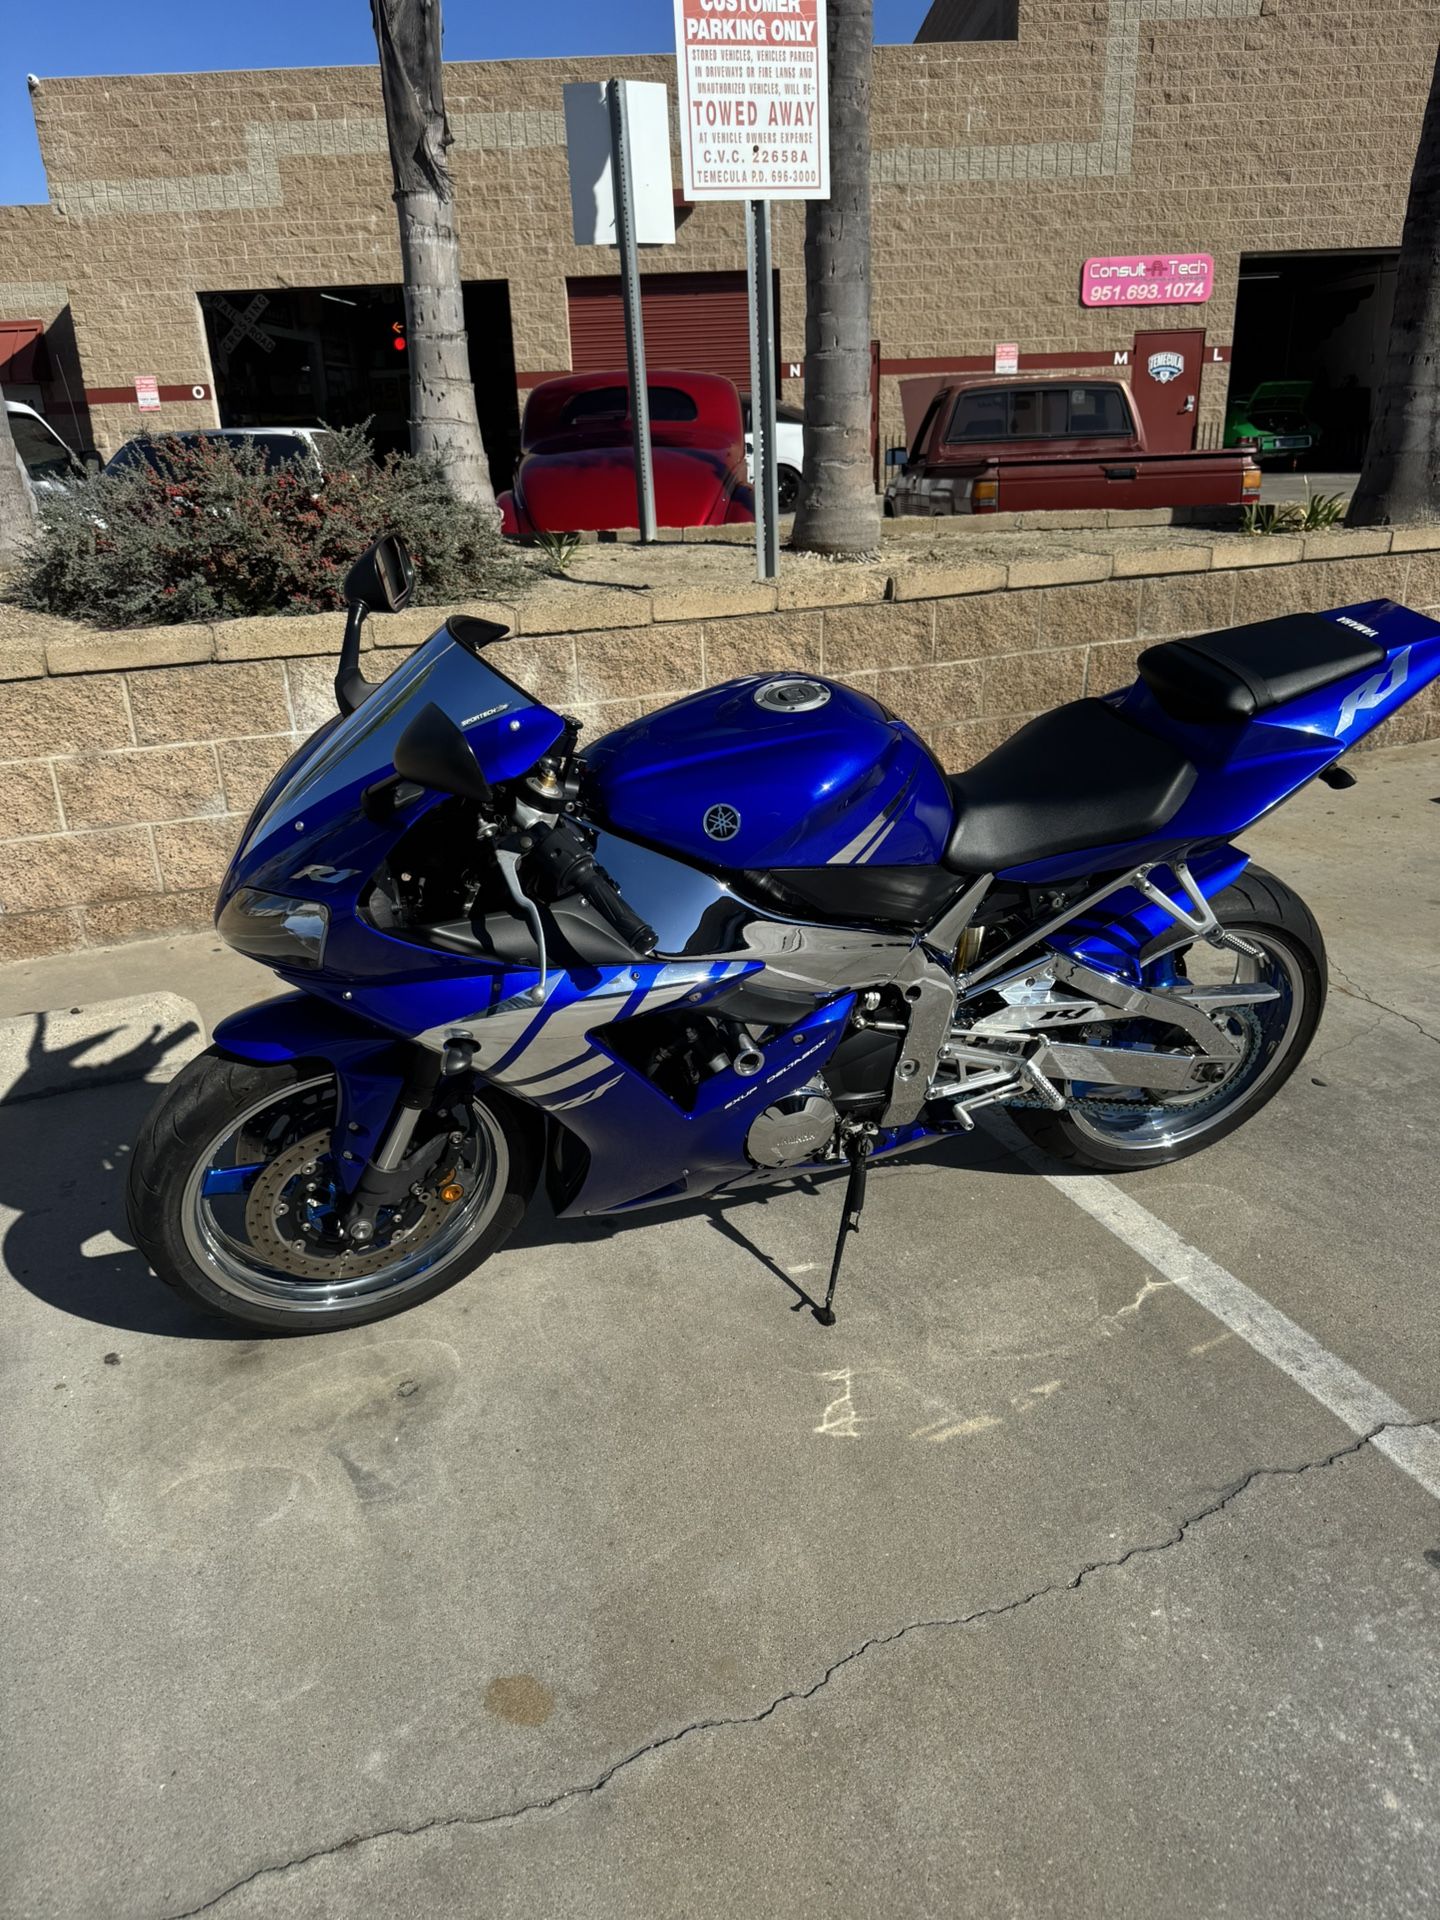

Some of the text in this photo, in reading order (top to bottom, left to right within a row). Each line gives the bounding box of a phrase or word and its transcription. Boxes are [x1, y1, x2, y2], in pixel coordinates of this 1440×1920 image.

[700, 0, 801, 12] CUSTOMER
[686, 18, 815, 42] PARKING ONLY
[692, 49, 814, 63] STORED VEHICLES, VEHICLES PARKED
[695, 66, 813, 79] IN DRIVEWAYS OR FIRE LANES AND
[697, 82, 746, 95] UNAUTHORIZED
[750, 83, 781, 97] VEHICLES,
[784, 83, 800, 96] WILL
[692, 100, 815, 127] TOWED AWAY
[699, 132, 813, 144] AT VEHICLE OWNERS EXPENSE
[703, 150, 809, 164] C.V.C. 22658A
[697, 170, 816, 184] TEMECULA P.D. 696-3000
[1090, 282, 1205, 300] 951.693.1074
[1113, 352, 1128, 365] M
[1213, 348, 1223, 361] L
[790, 364, 801, 377] N
